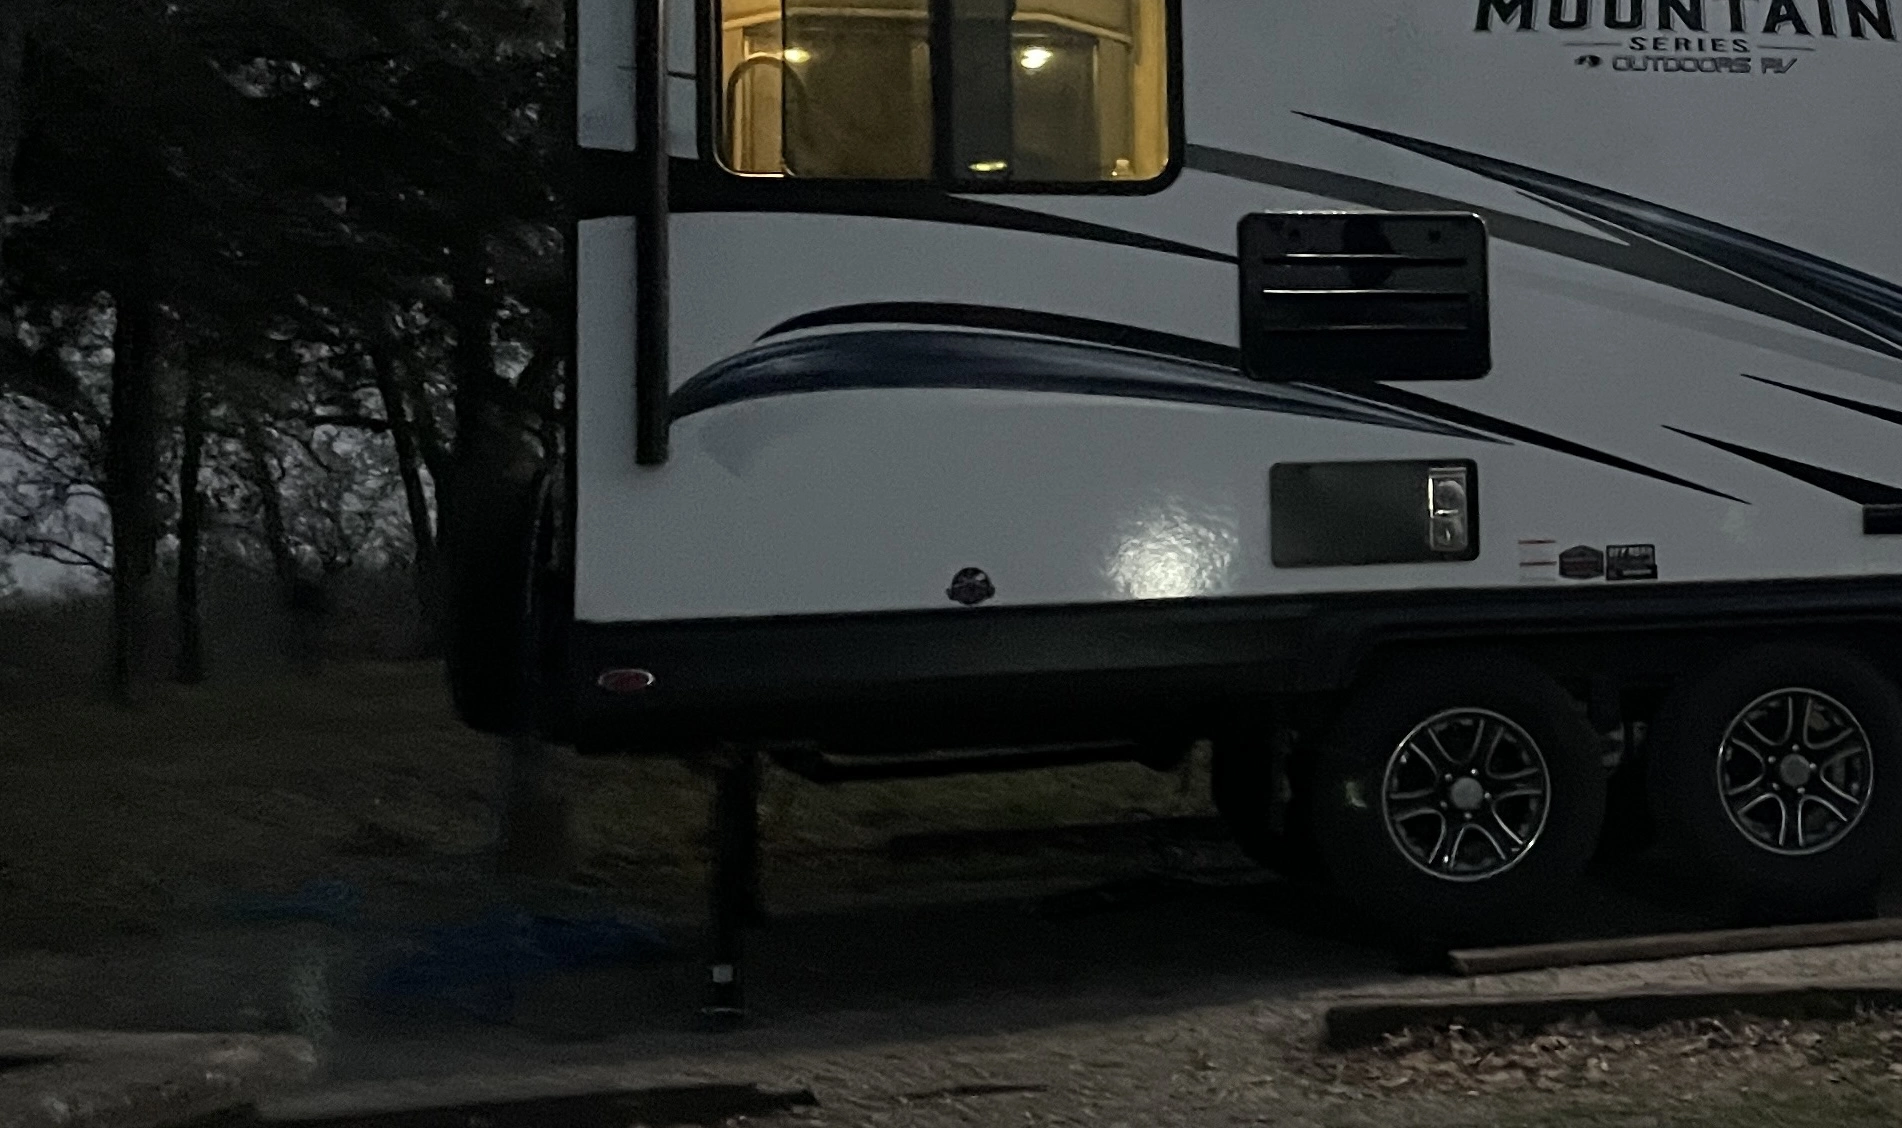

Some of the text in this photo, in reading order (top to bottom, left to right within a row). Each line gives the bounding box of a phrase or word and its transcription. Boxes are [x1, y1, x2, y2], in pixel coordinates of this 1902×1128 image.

[1629, 36, 1750, 53] SERIES
[1612, 55, 1798, 74] OUTDOORS RV
